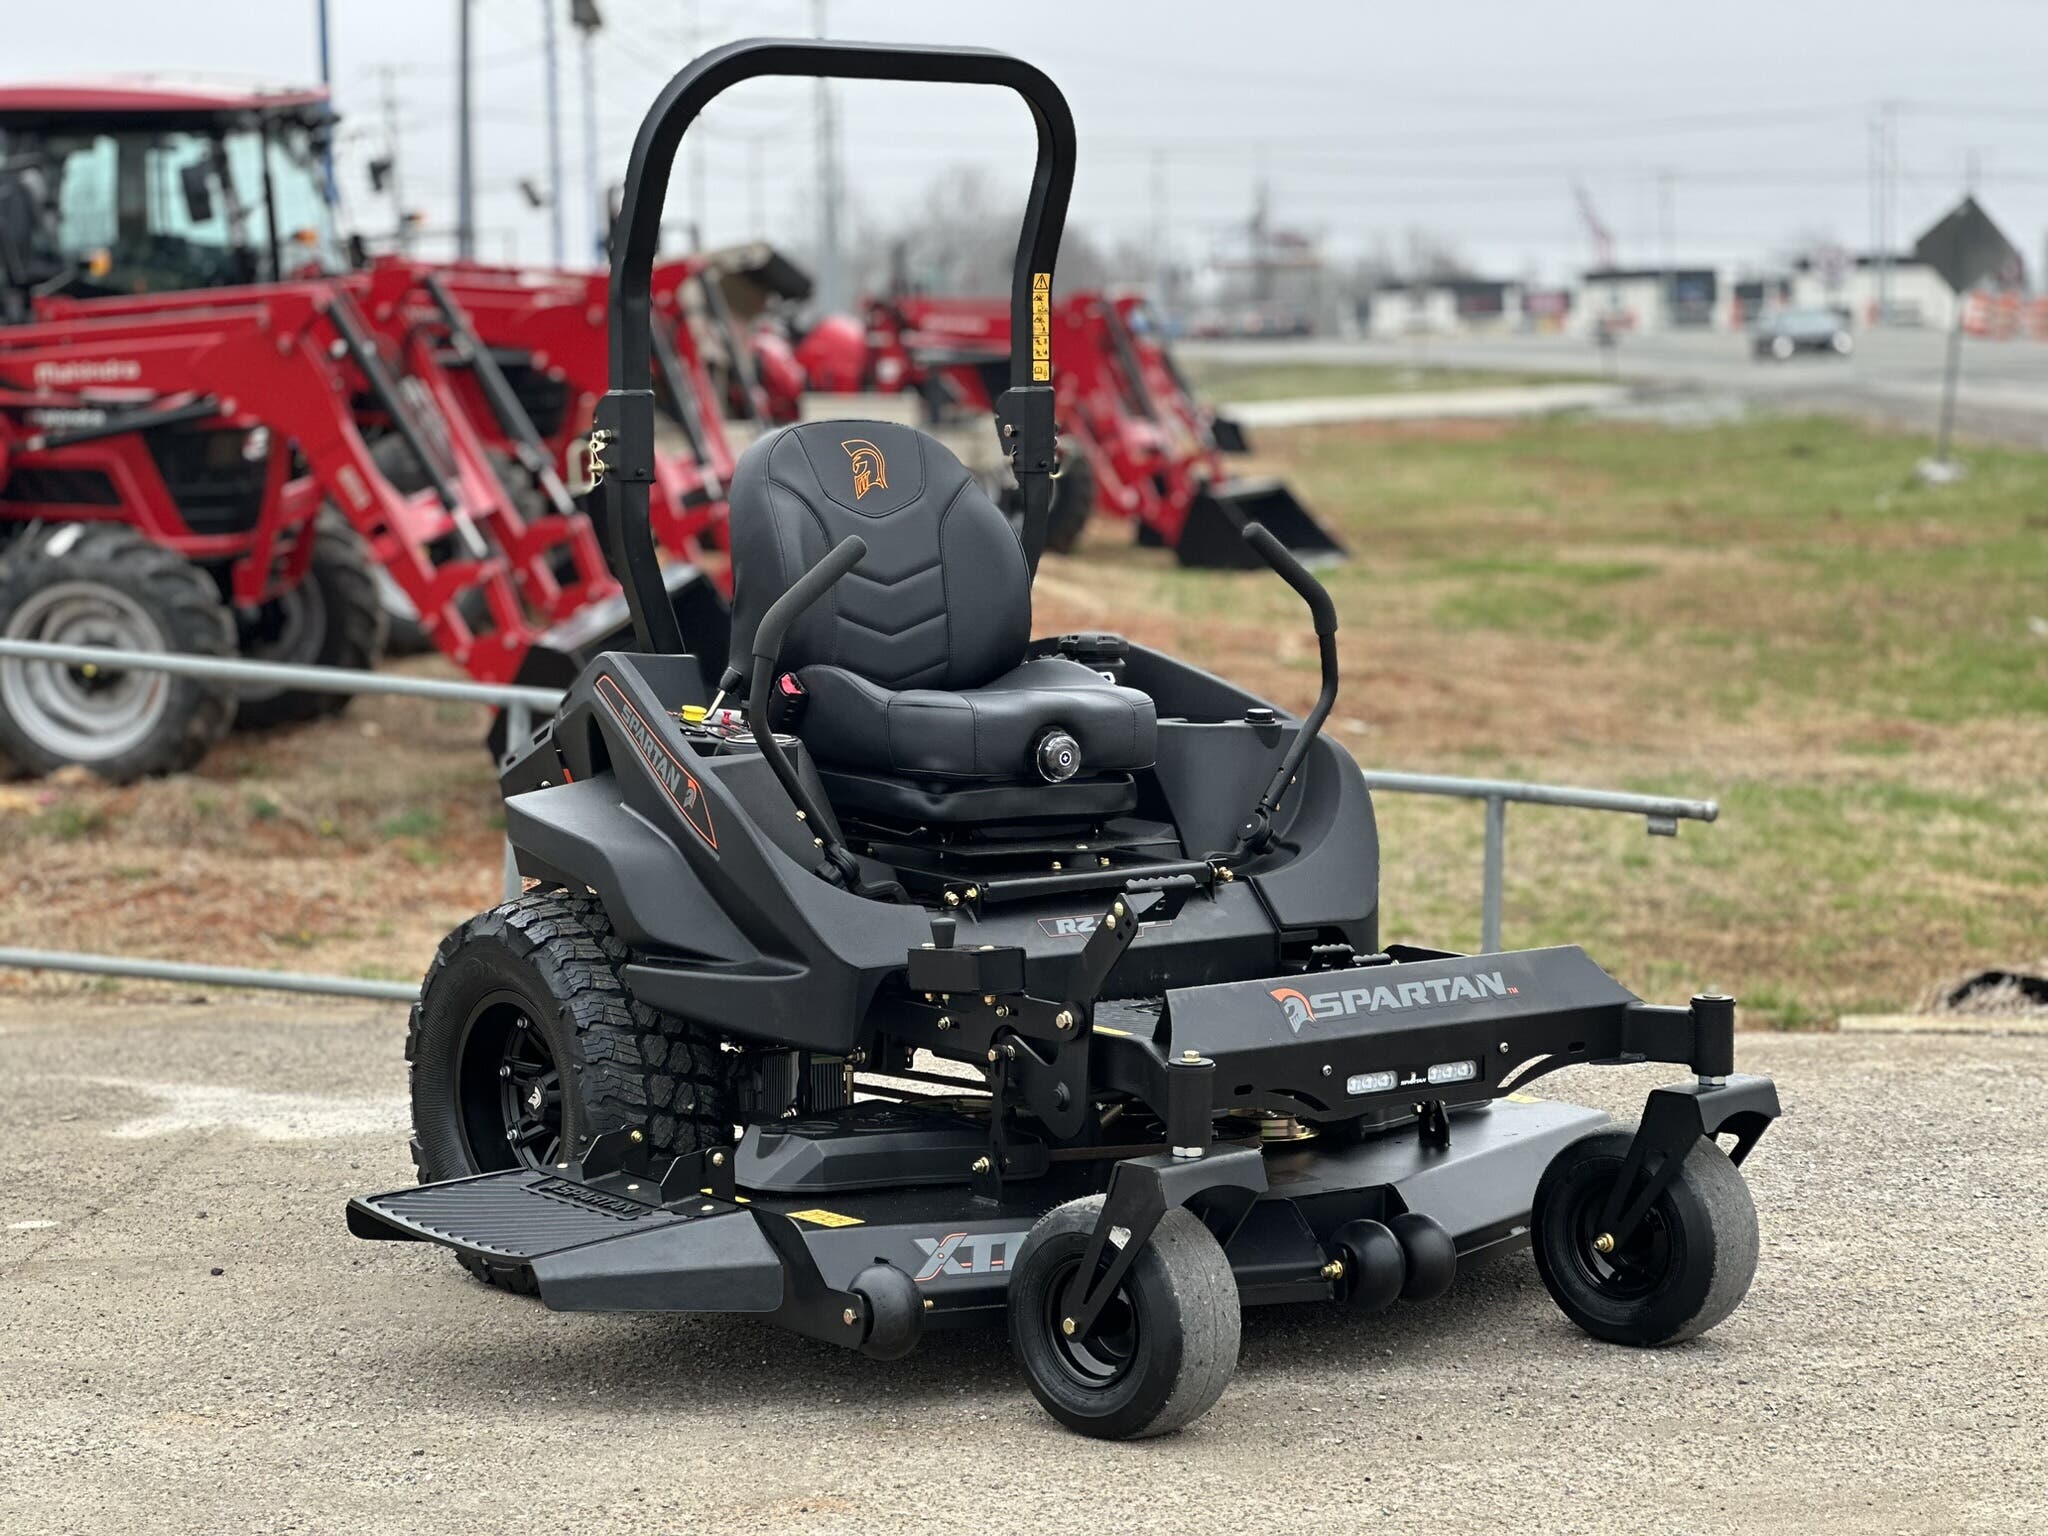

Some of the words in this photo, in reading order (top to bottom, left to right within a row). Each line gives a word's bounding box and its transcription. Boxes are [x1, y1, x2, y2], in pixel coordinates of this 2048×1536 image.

[620, 704, 681, 793] SPARTAN
[1309, 971, 1506, 1019] SPARTAN
[554, 1184, 641, 1214] SPARTAN
